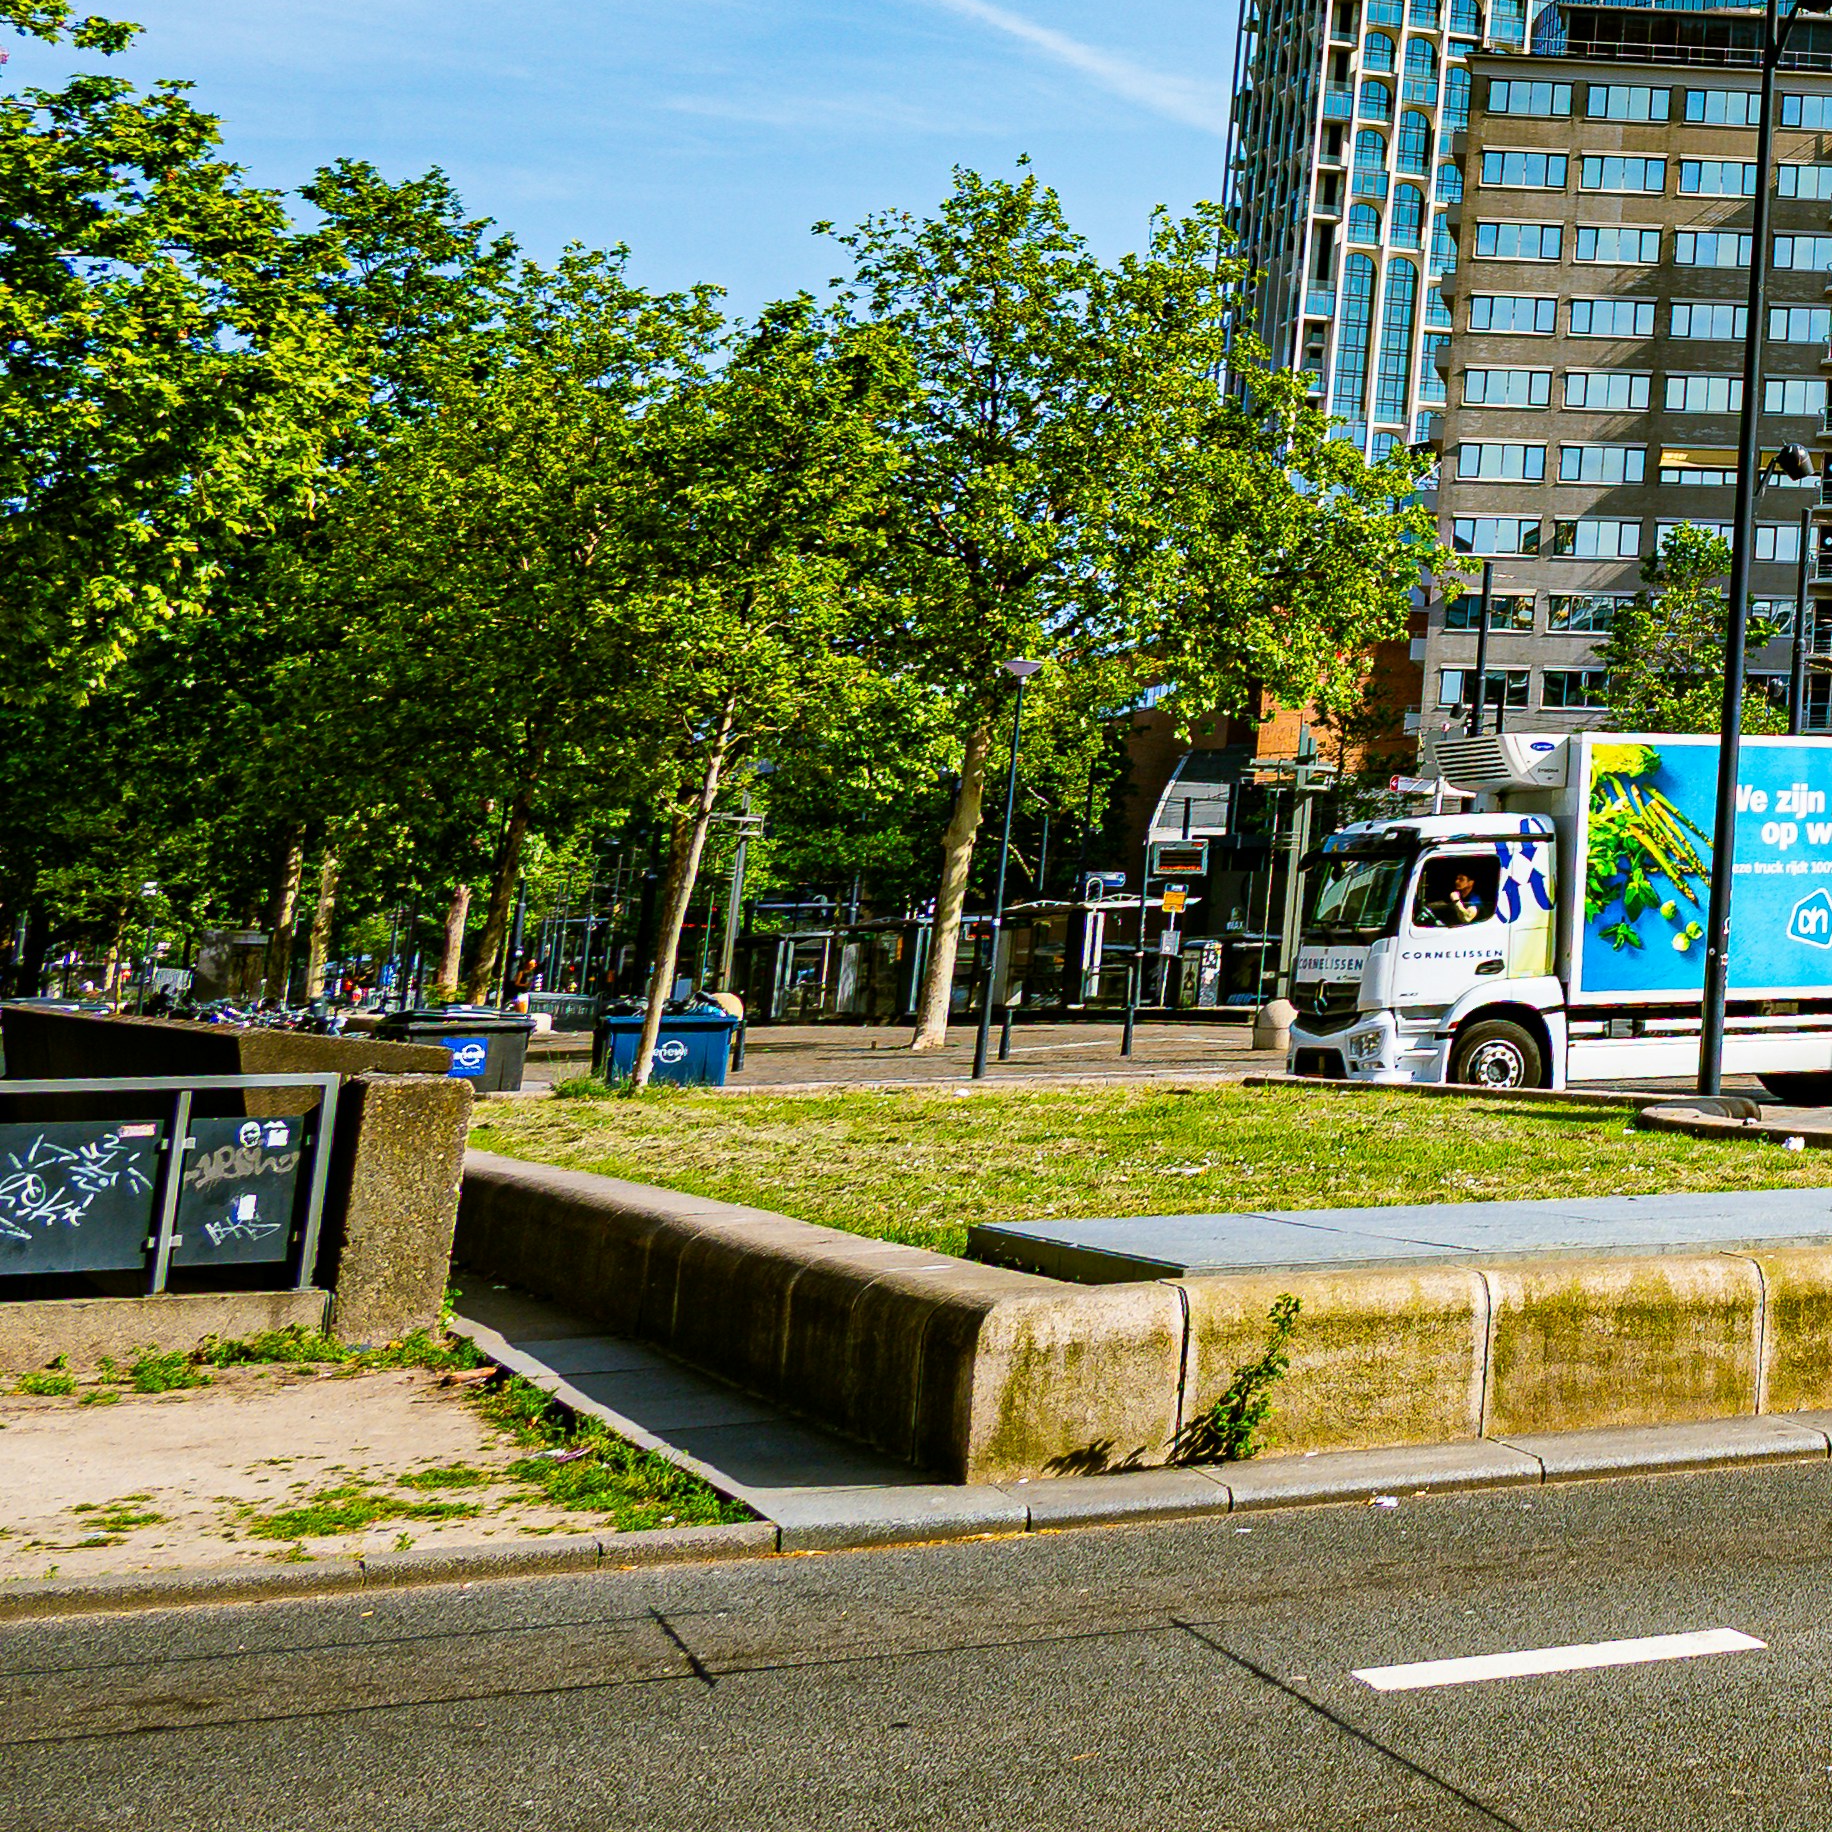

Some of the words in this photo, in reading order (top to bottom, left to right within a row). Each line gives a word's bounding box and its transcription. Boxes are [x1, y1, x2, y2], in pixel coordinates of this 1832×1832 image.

[1775, 782, 1826, 820] zijn
[1761, 821, 1798, 851] op
[1732, 862, 1752, 874] eze
[1754, 860, 1784, 874] truck
[1401, 949, 1503, 960] CORNELISSEN
[1298, 957, 1364, 971] CORNELISSEN
